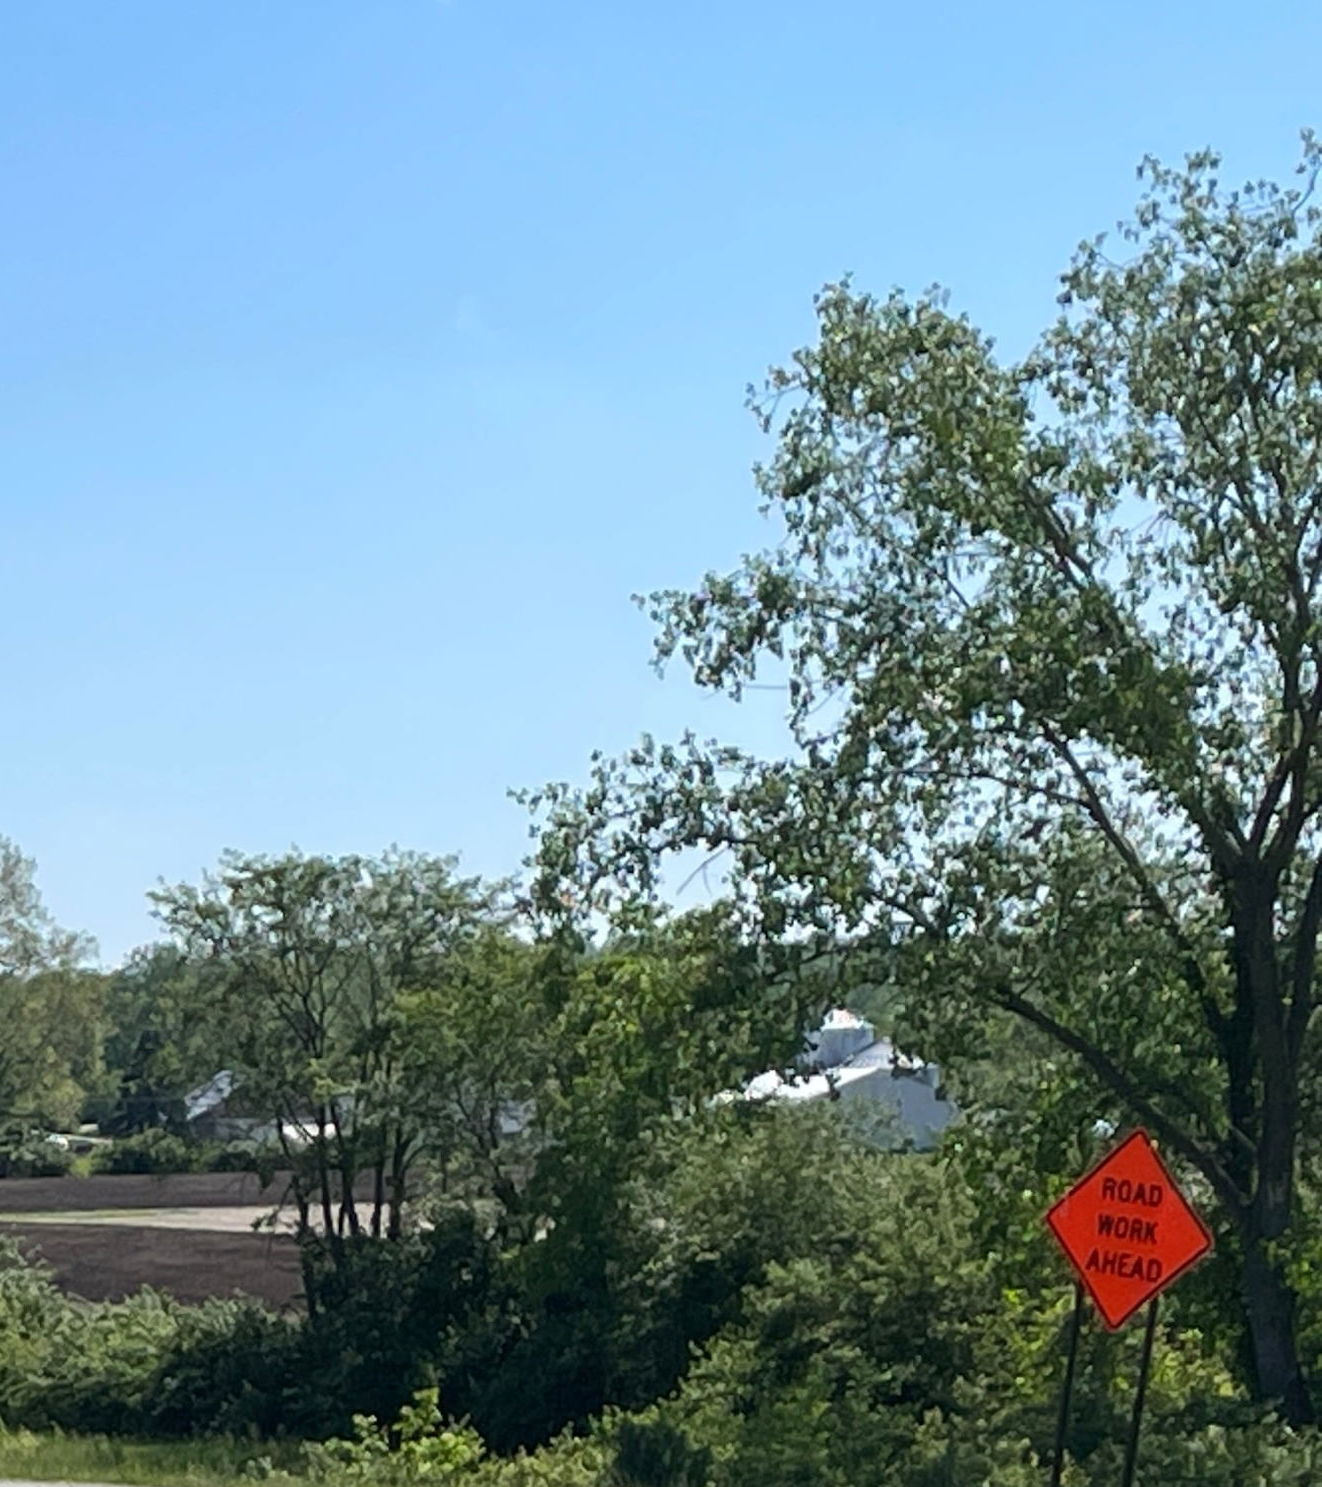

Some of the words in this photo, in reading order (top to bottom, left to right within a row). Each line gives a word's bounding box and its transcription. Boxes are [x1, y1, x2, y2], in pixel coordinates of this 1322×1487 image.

[1102, 1177, 1162, 1207] ROAD
[1098, 1214, 1159, 1245] WORK
[1085, 1249, 1162, 1282] AHEAD
